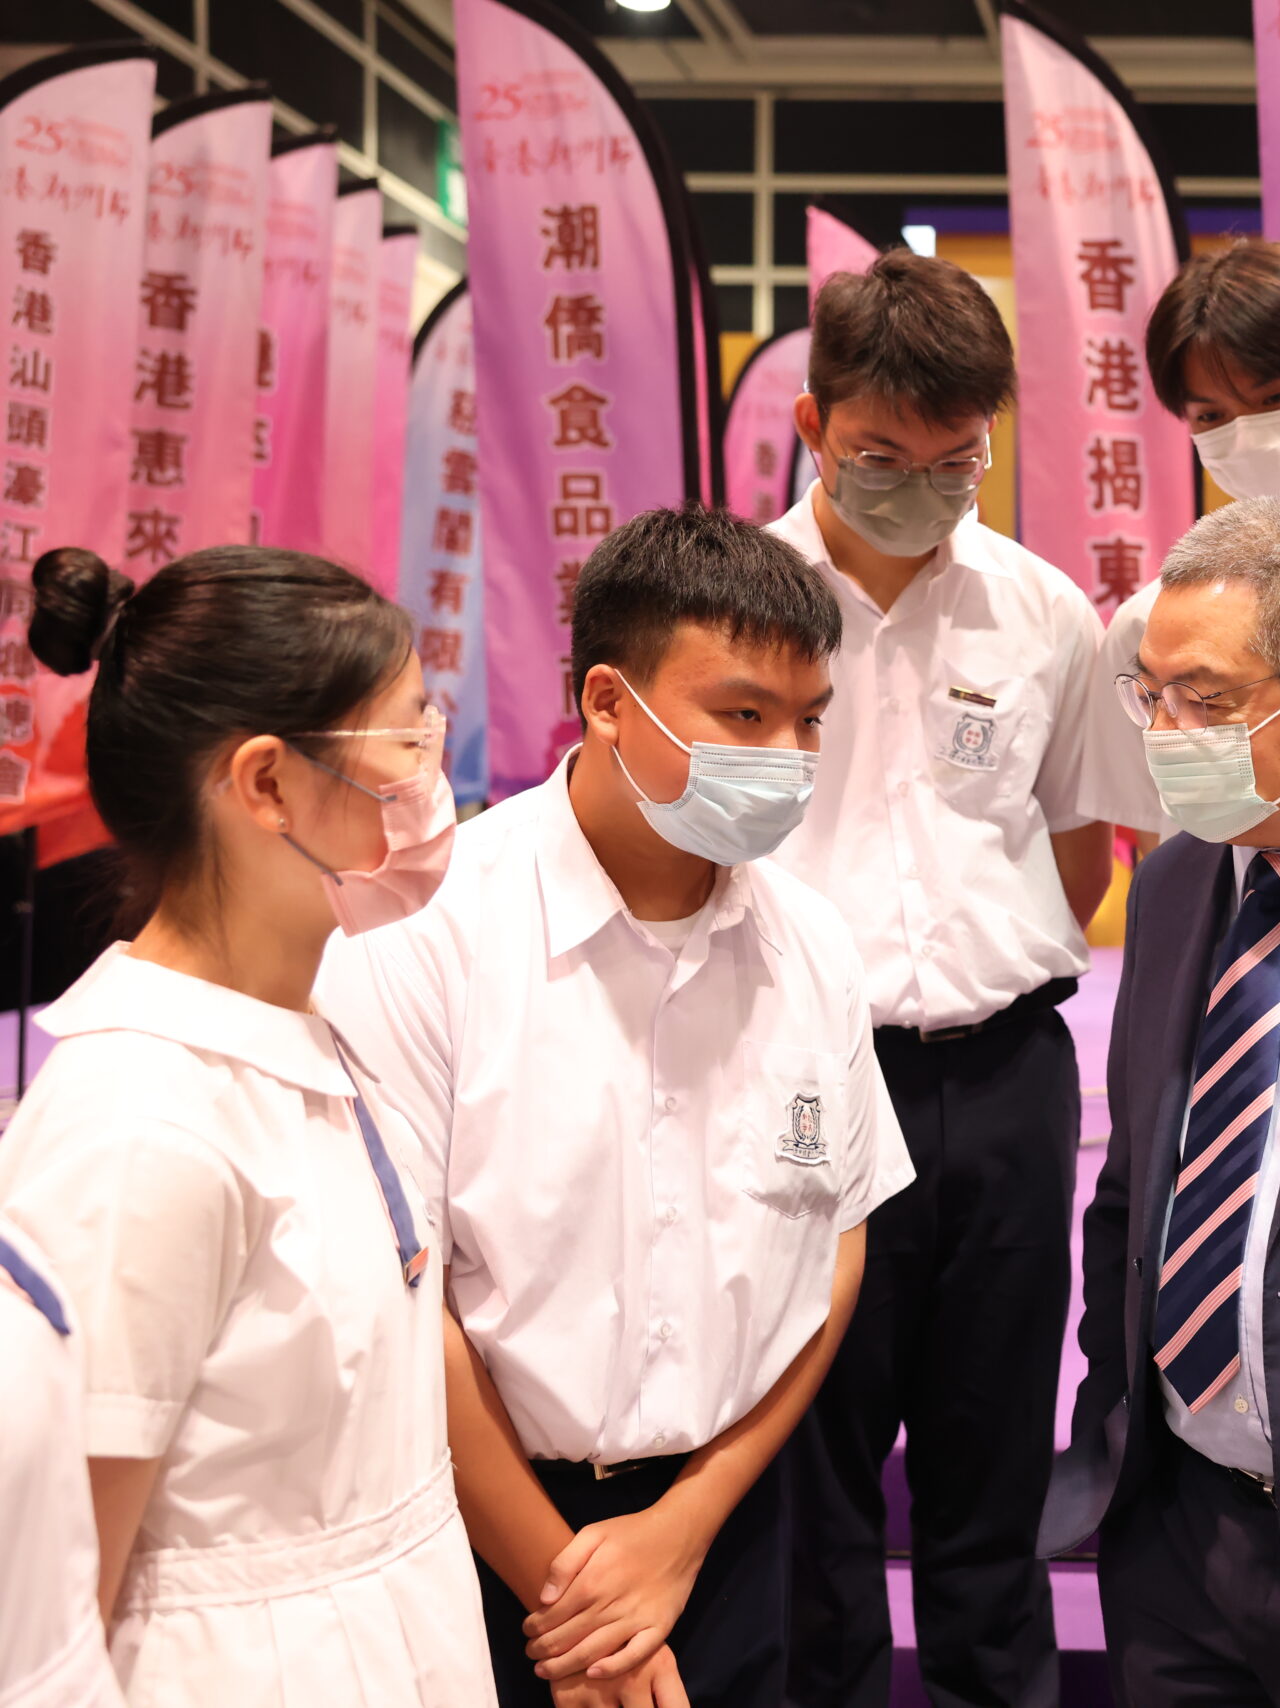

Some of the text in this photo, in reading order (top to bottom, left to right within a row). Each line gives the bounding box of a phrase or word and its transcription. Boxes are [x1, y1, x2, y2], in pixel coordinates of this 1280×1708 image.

[16, 115, 64, 154] 25
[474, 84, 523, 121] 25
[125, 271, 197, 563] 香港惠來
[541, 204, 613, 716] 潮僑食品
[1077, 240, 1144, 605] 香港揭東
